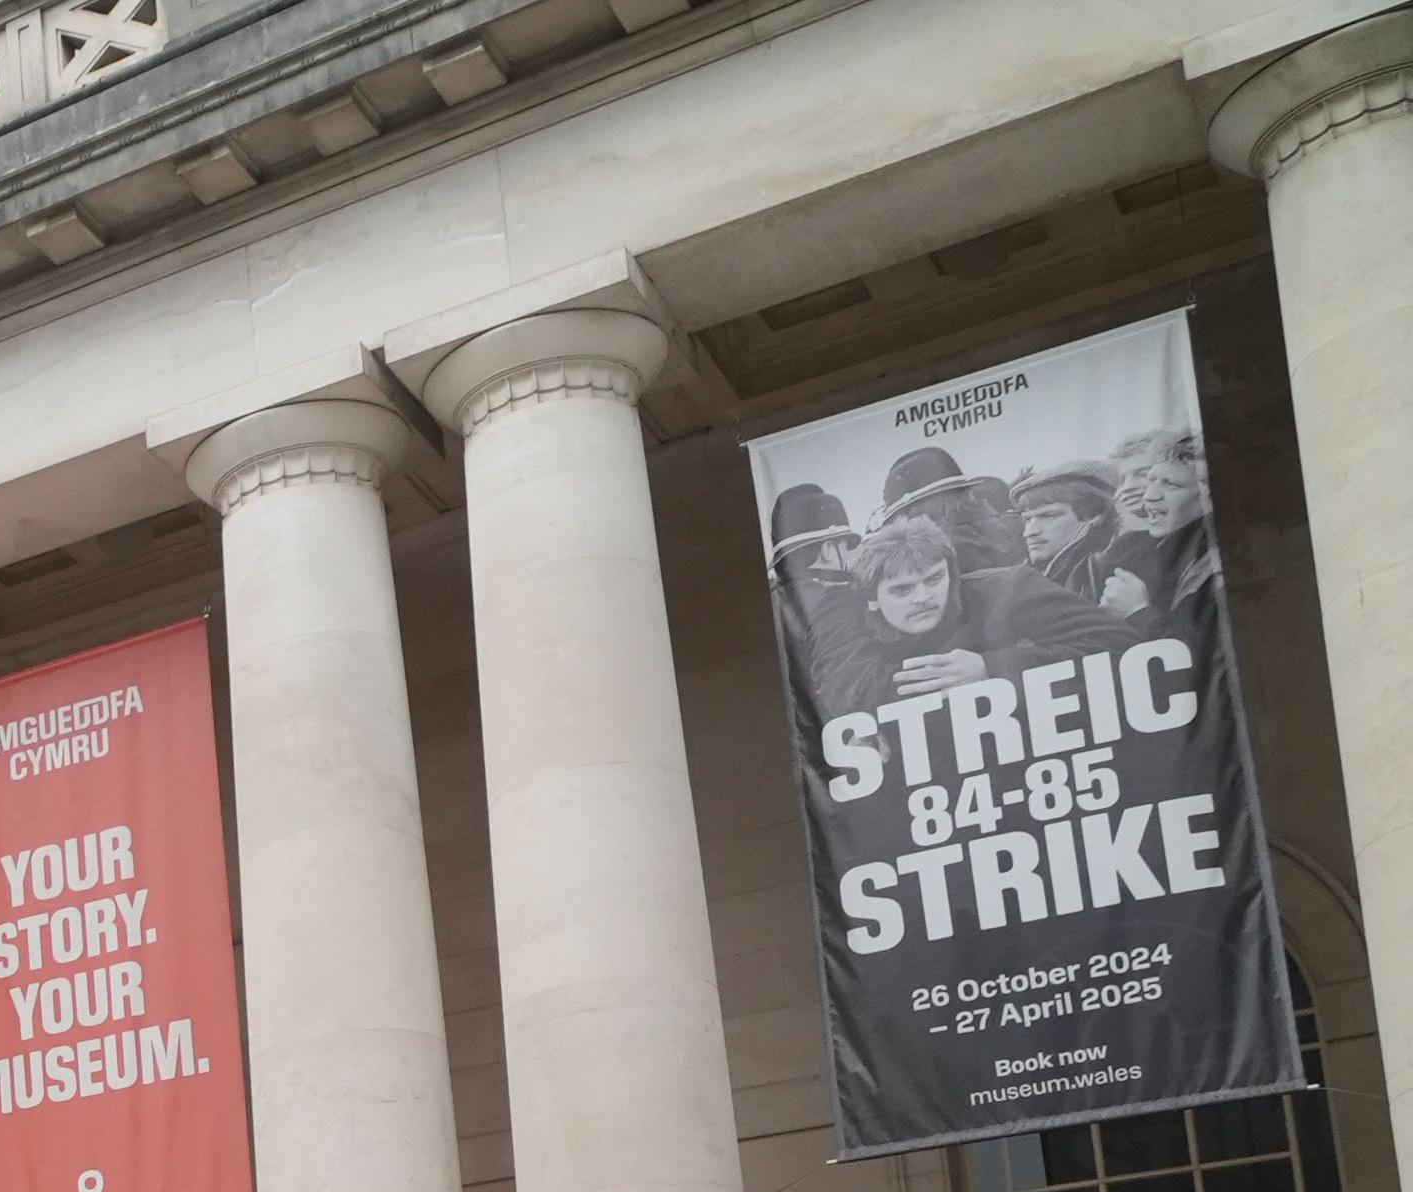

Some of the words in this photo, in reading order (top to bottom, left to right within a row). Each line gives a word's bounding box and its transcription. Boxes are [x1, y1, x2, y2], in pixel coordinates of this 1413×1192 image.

[893, 372, 1029, 428] AMGUEDDFA
[922, 401, 1004, 438] CYMRU
[821, 638, 1198, 803] STREIC
[9, 728, 110, 781] CYMRU
[908, 747, 1120, 846] 84-85
[0, 825, 135, 908] YOUR
[839, 793, 1225, 954] STRIKE
[9, 961, 145, 1041] YOUR
[911, 984, 949, 1012] 26
[956, 962, 1080, 1001] October
[1088, 943, 1172, 977] 2024
[955, 1007, 991, 1035] 27
[999, 994, 1073, 1026] April
[1081, 977, 1163, 1011] 2025
[969, 1064, 1143, 1106] museum.wales
[994, 1053, 1054, 1078] Book
[1058, 1044, 1108, 1066] now
